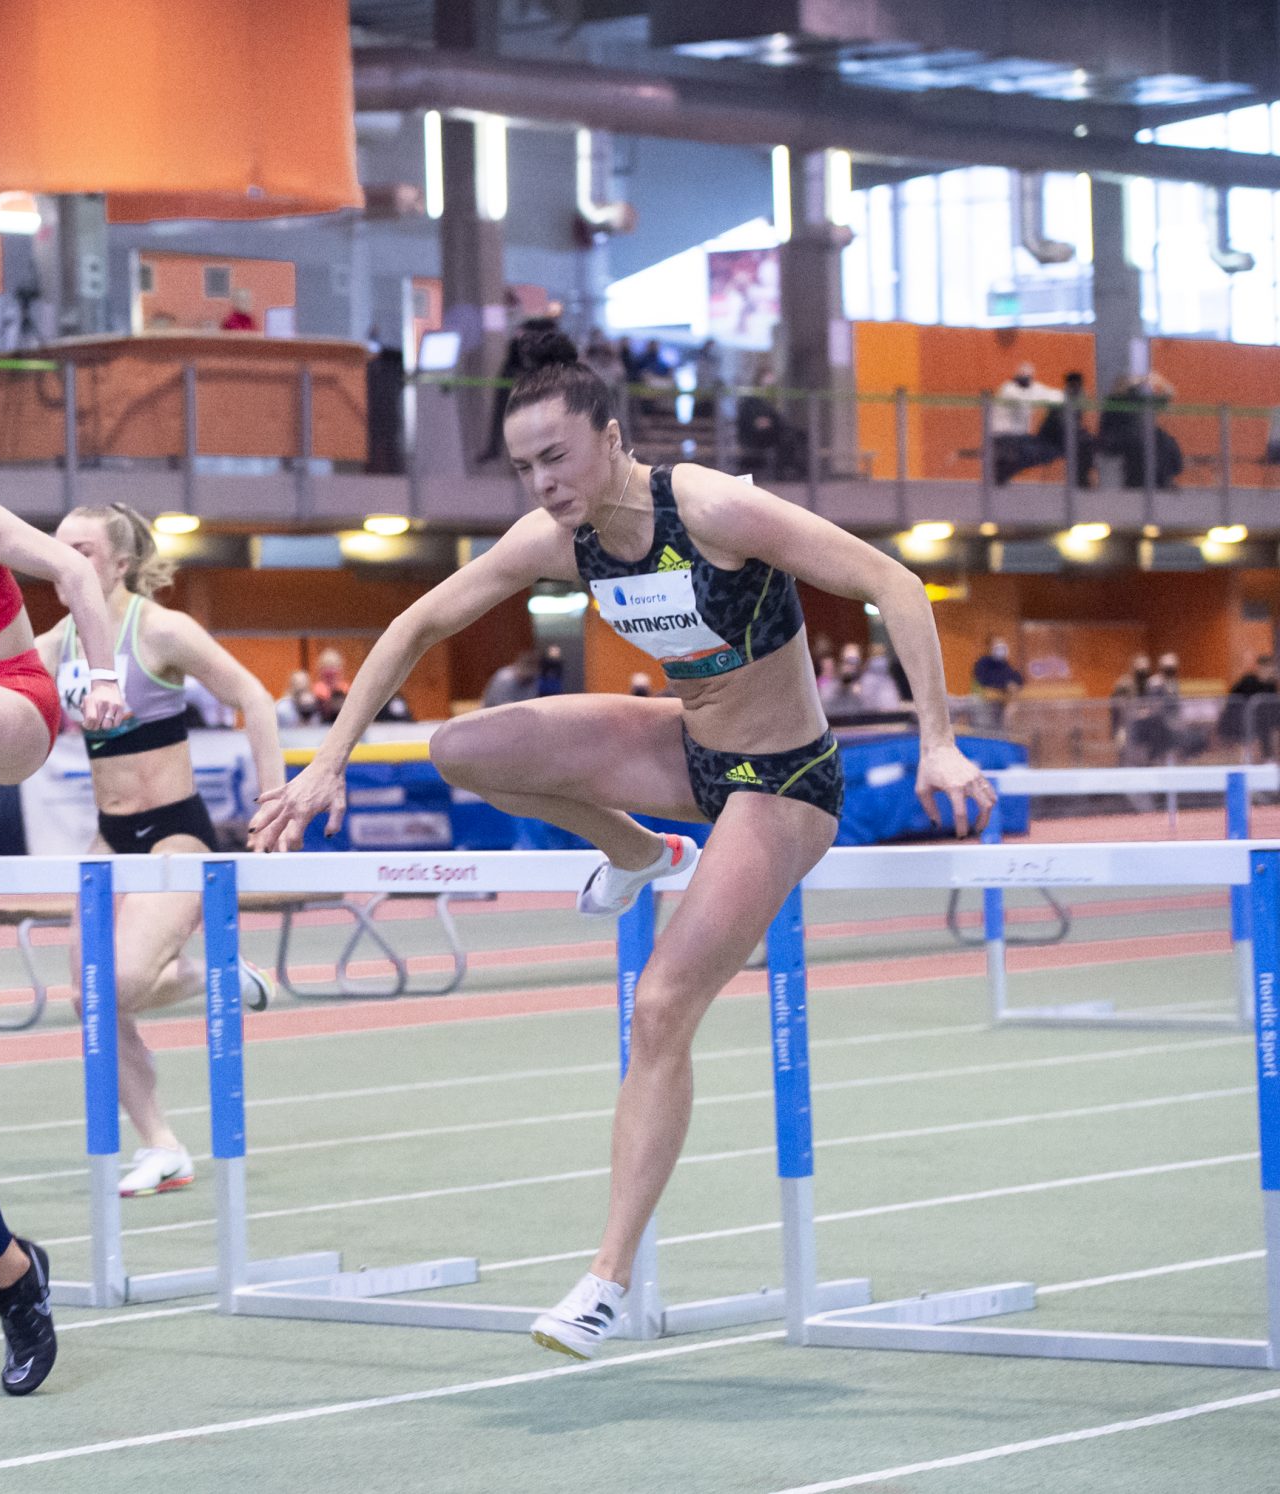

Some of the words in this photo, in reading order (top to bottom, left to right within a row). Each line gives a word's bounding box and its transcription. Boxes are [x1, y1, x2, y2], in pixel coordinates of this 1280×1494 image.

[629, 593, 667, 605] favorte
[613, 612, 699, 634] HUNTINGTON
[725, 772, 763, 785] adidas
[433, 864, 477, 885] Sport
[1259, 1030, 1279, 1078] Sport
